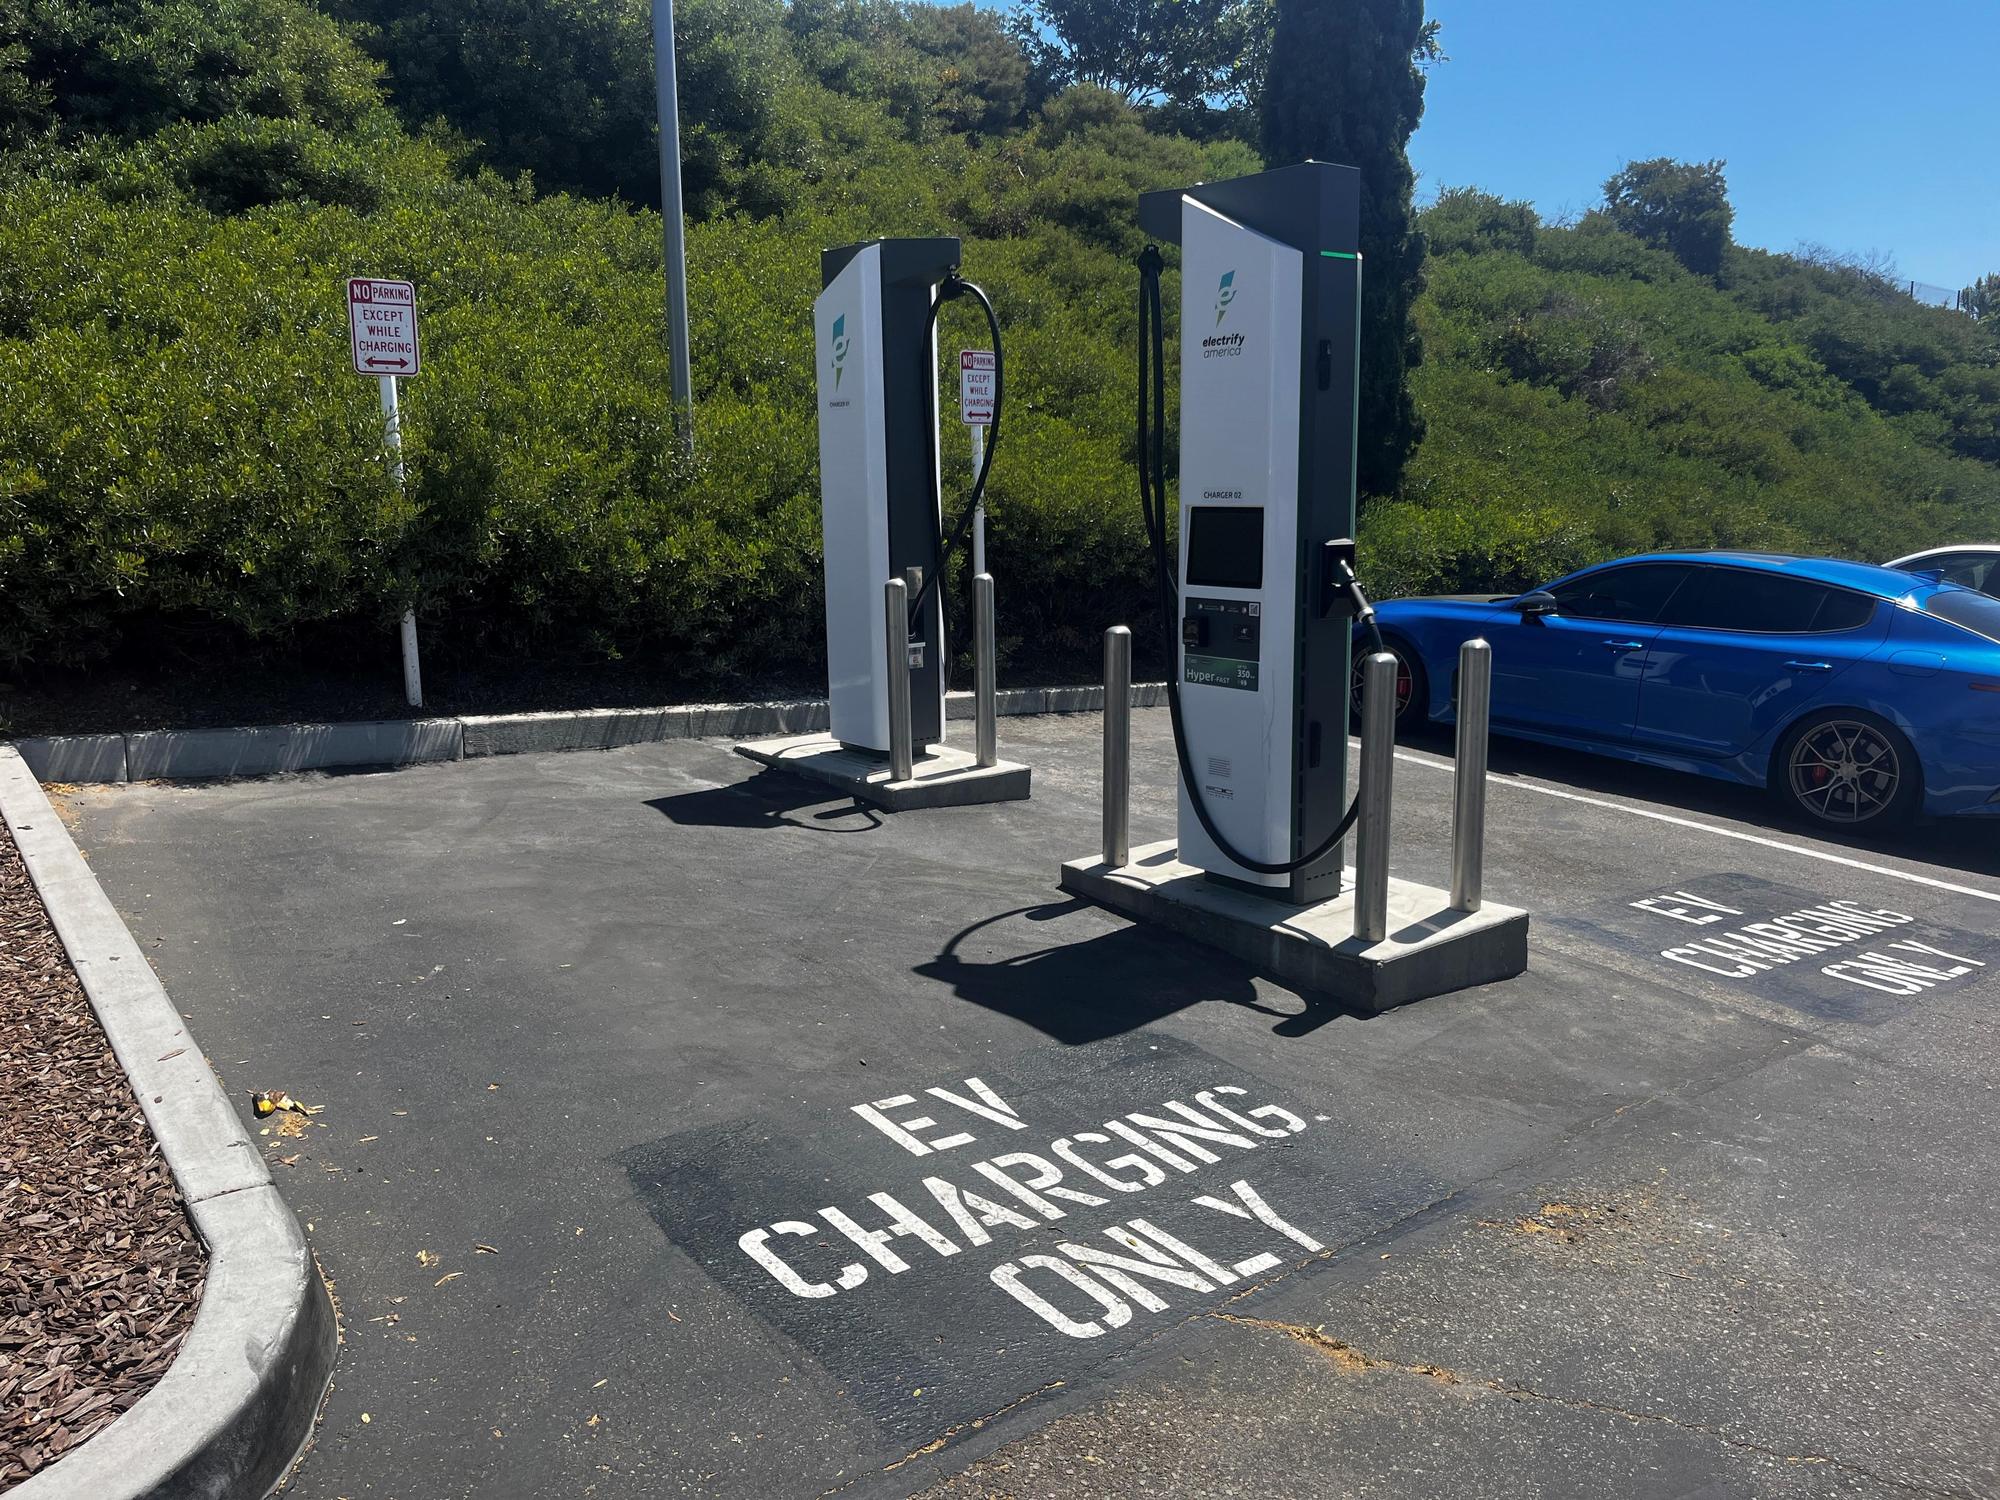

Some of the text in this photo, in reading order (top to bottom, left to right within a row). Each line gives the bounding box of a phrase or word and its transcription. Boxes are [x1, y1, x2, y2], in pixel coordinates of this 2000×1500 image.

[353, 283, 410, 301] NO PARKING
[362, 309, 404, 322] EXCEPT
[367, 325, 402, 338] WHILE
[359, 340, 412, 353] CHARGING
[1202, 333, 1245, 347] electrify
[1203, 347, 1242, 359] america
[962, 354, 995, 368] NO PARKING
[967, 374, 990, 384] EXCEPT
[969, 386, 988, 396] WHILE
[964, 398, 994, 408] CHARGING
[1203, 491, 1242, 499] CHARGER 02
[1237, 669, 1251, 679] 350
[1629, 891, 1744, 925] EV
[1660, 899, 1914, 978] CHARGING
[1821, 939, 1986, 995] ONLY
[850, 1076, 1029, 1157] EV
[738, 1085, 1307, 1299] CHARGING
[989, 1180, 1326, 1339] ONLY
